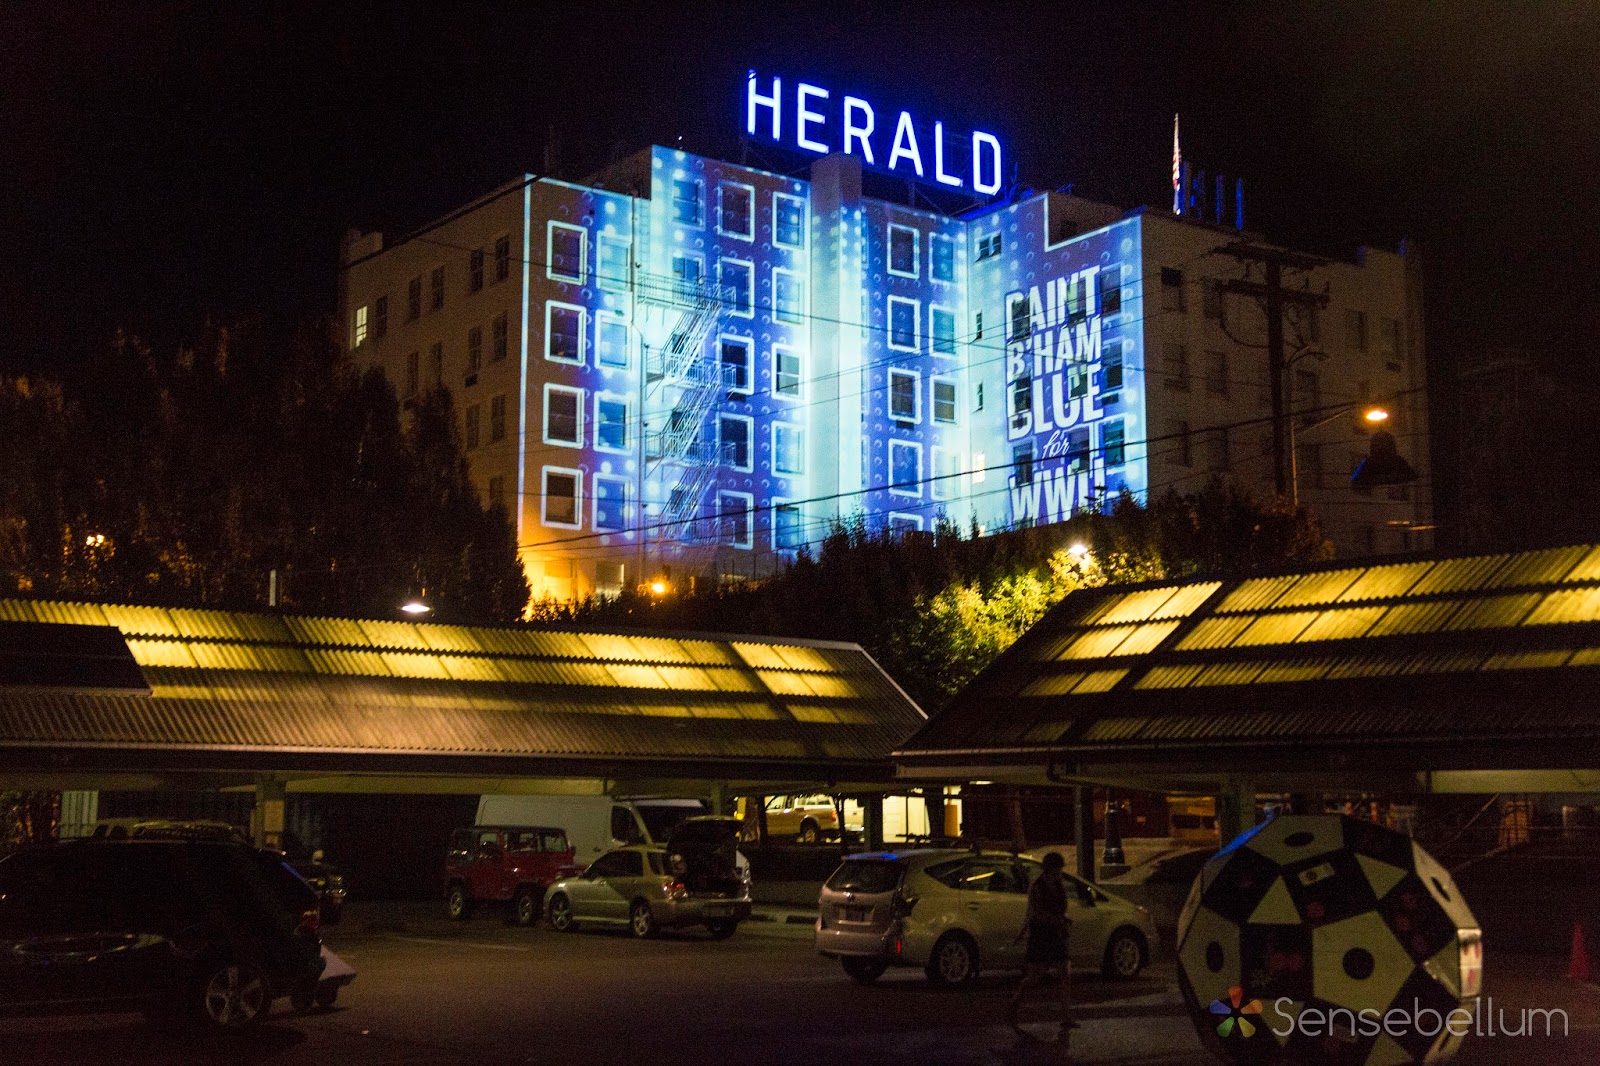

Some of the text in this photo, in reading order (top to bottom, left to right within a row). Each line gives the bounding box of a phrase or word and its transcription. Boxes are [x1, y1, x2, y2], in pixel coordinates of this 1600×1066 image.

[747, 69, 1001, 196] HERALD
[1006, 315, 1102, 384] B'HAM
[1041, 429, 1070, 470] for
